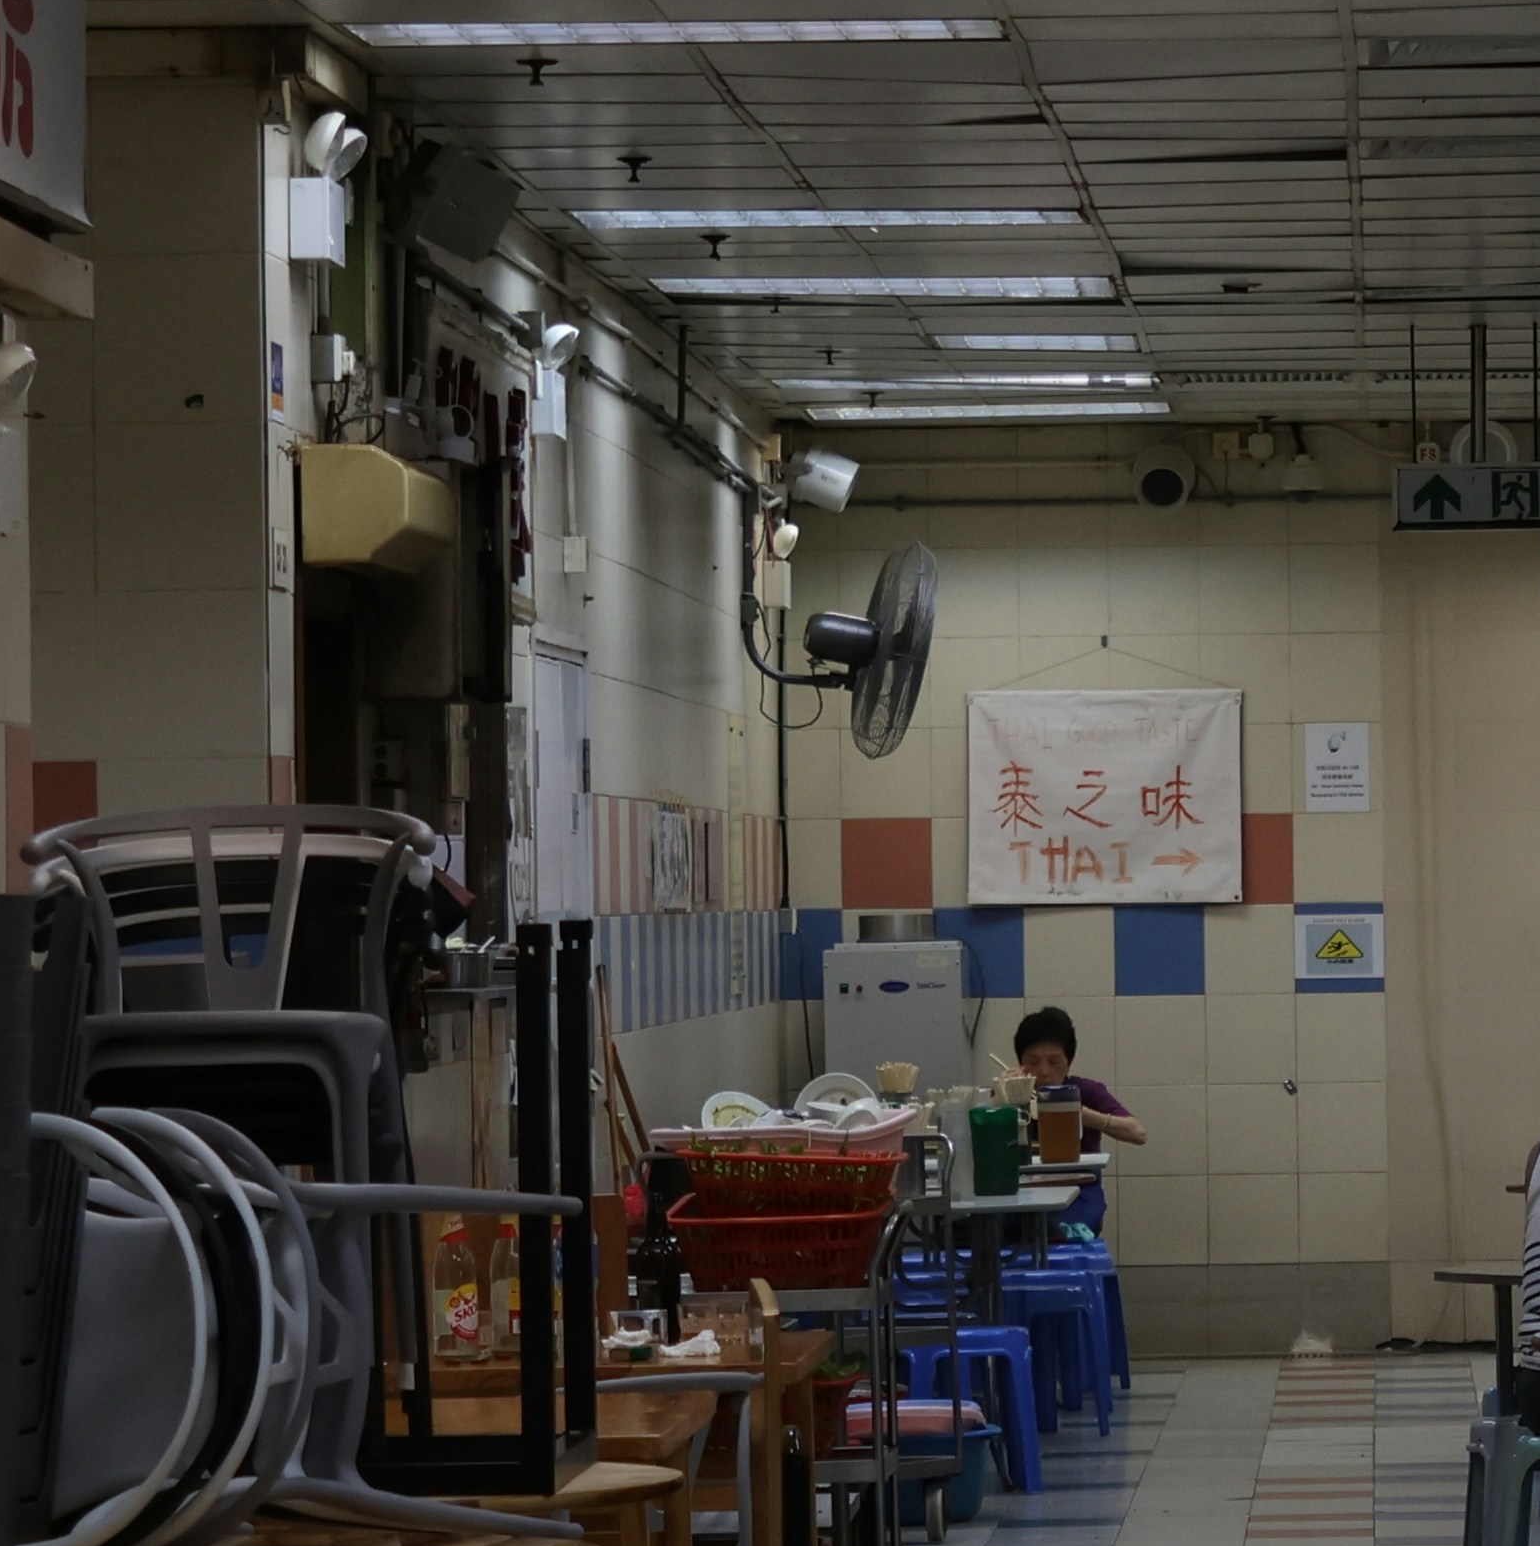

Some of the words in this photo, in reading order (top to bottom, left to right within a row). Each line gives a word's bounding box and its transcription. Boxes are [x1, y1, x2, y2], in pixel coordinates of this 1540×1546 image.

[989, 761, 1204, 836] 泰之味
[1007, 836, 1134, 886] THAI
